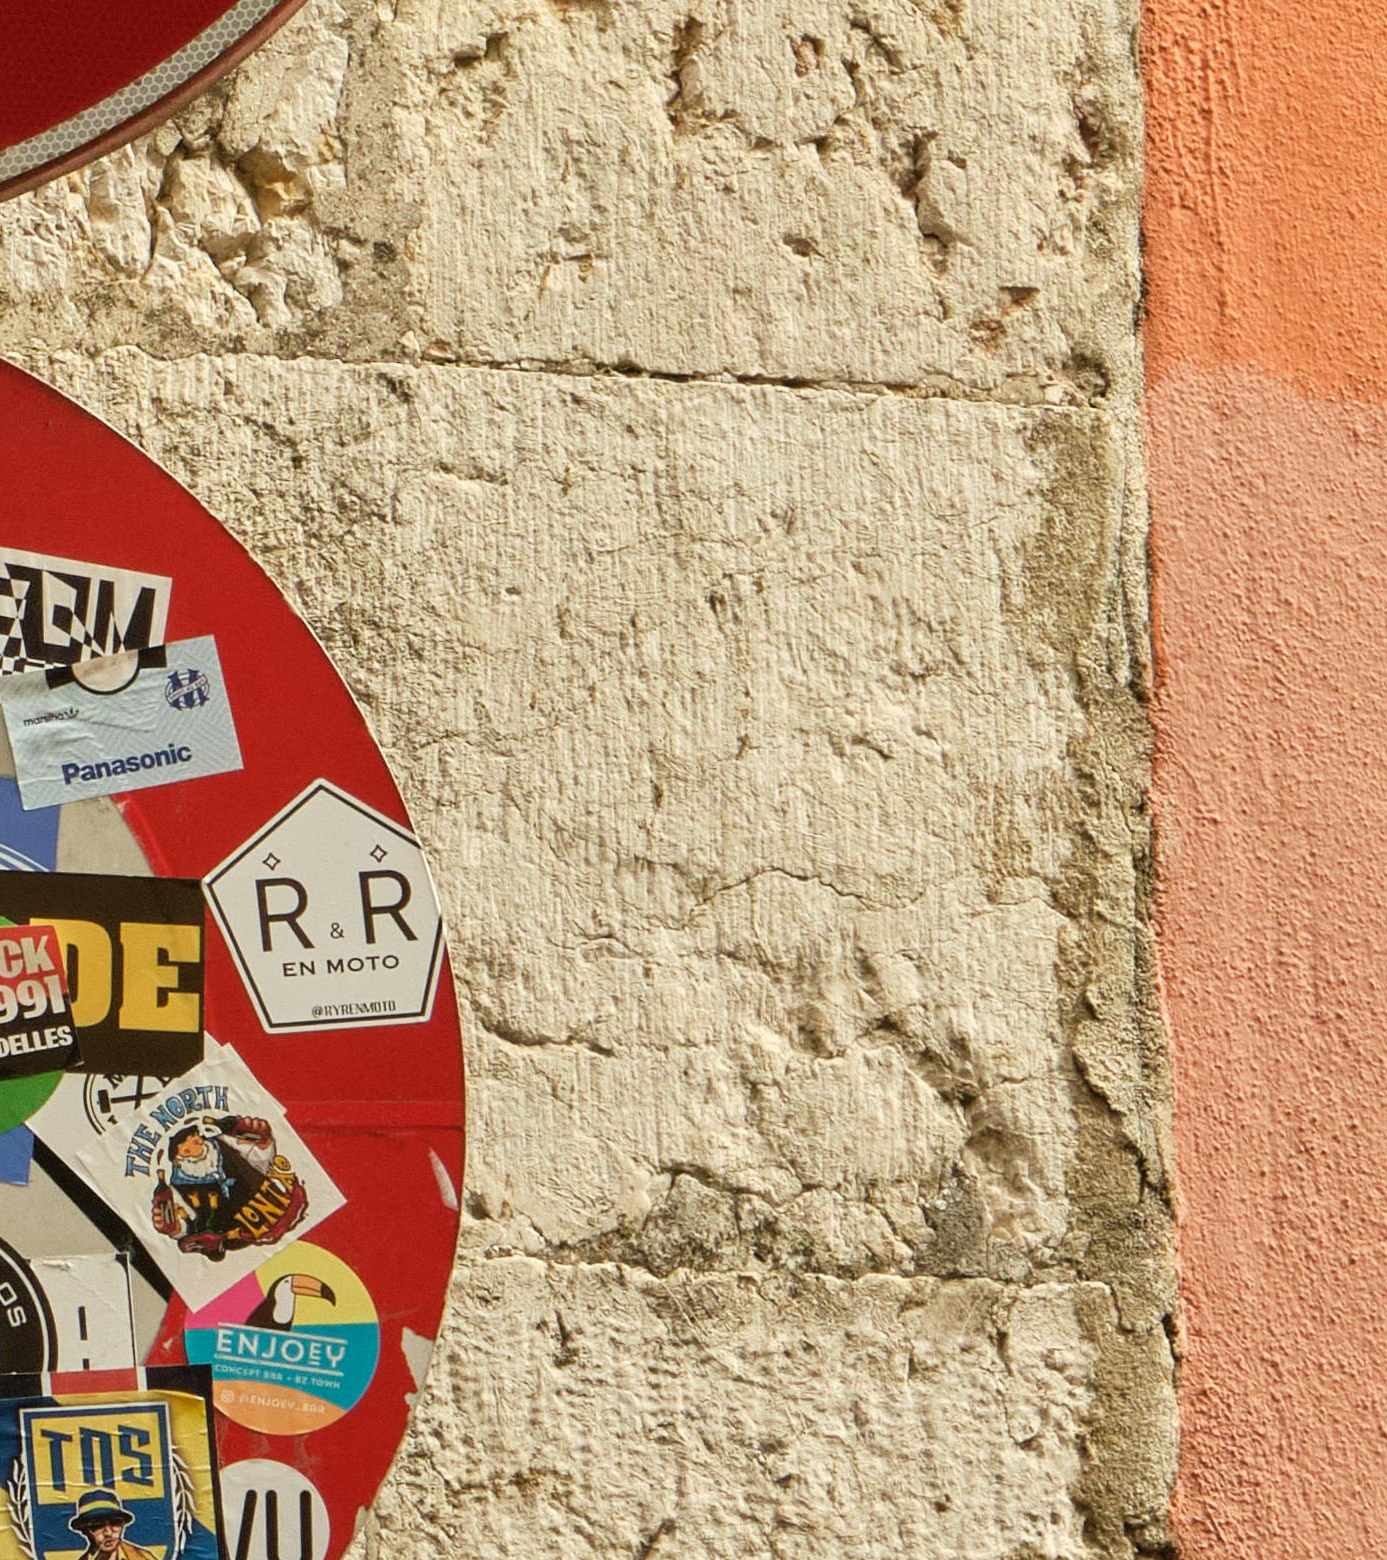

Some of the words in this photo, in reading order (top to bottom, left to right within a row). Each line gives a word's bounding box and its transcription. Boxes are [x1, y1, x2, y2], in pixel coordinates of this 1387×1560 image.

[61, 743, 193, 785] Panasonic
[255, 877, 315, 953] R
[330, 922, 345, 940] &
[358, 869, 419, 945] R
[282, 961, 316, 977] EN
[327, 954, 400, 975] MOTO
[311, 1000, 396, 1019] @RYRENMOTO
[125, 1123, 161, 1178] THE
[150, 1085, 230, 1132] NORTH
[216, 1328, 347, 1369] ENJOEY
[214, 1363, 261, 1377] CONCEPT
